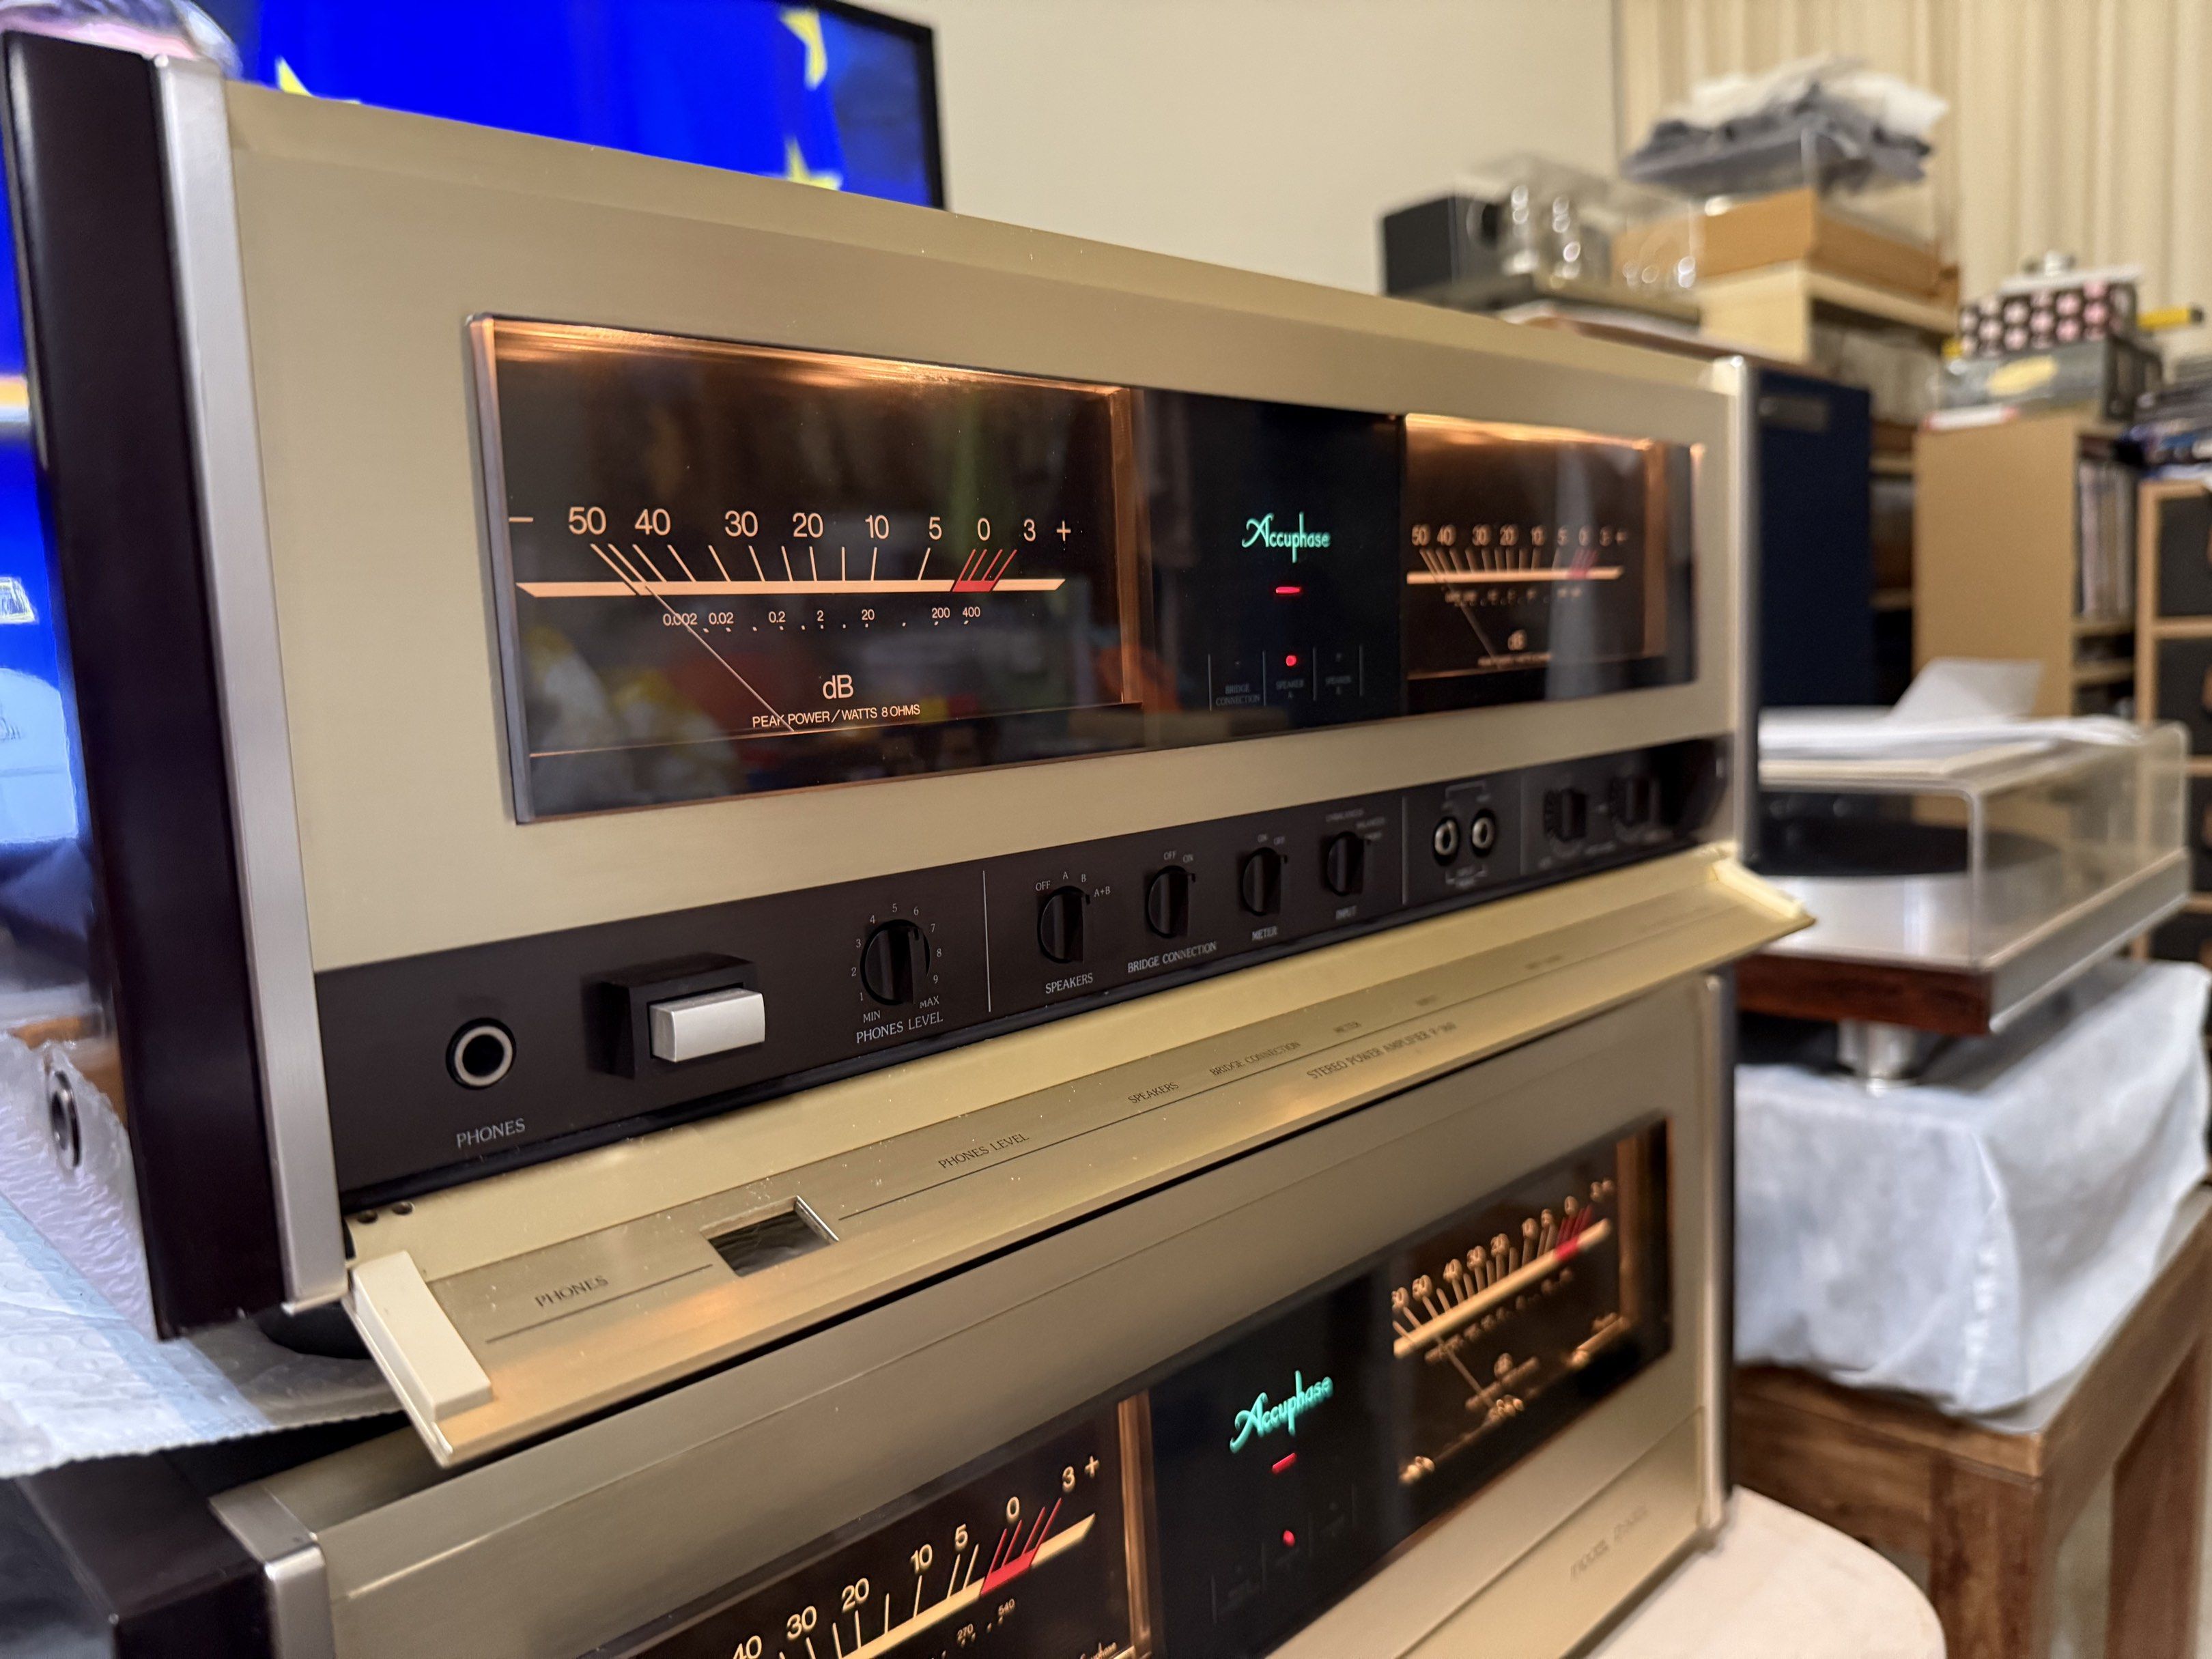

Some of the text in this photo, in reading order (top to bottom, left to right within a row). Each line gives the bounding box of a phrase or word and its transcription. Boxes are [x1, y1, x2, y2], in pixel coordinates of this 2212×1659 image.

[568, 507, 607, 535] 50
[634, 509, 671, 536] 40
[724, 510, 758, 537] 30
[793, 512, 824, 538] 20
[865, 514, 890, 539] 10
[928, 516, 942, 539] 5
[977, 517, 991, 541] 0
[1023, 519, 1036, 541] 3
[1241, 511, 1332, 563] Accuphase
[662, 606, 981, 626] 0.002 0.02 0.2 2 20 200 400
[823, 675, 853, 699] dB
[752, 714, 785, 728] PEAK
[881, 708, 888, 717] 8
[890, 704, 920, 717] OHMS
[1163, 851, 1177, 861] OFF
[1035, 871, 1111, 898] OFF A B A+B
[892, 903, 898, 913] 5
[913, 906, 919, 916] 6
[870, 915, 875, 924] 4
[931, 923, 936, 933] 7
[855, 939, 861, 948] 3
[1251, 925, 1278, 941] METER
[936, 948, 941, 957] 8
[1127, 941, 1217, 974] BRIDGE CONNECTION
[851, 967, 857, 976] 2
[933, 974, 939, 984] 9
[1045, 972, 1093, 994] SPEAKERS
[860, 992, 864, 1001] 1
[920, 995, 939, 1008] MAX
[856, 1011, 944, 1043] PHONES LEVEL
[863, 1010, 881, 1023] MIN
[1209, 1040, 1301, 1077] BRIDGE CONNECTION
[1306, 1061, 1348, 1079] STEREO
[1345, 1047, 1385, 1066] POWER
[1382, 1029, 1431, 1054] AMPLIFIER
[1128, 1081, 1180, 1104] SPEAKERS
[456, 1118, 526, 1148] PHONES
[938, 1133, 1030, 1169] PHONES LEVEL
[534, 1275, 609, 1307] PHONES
[1230, 1370, 1335, 1454] Accuphase
[733, 1635, 763, 1659] 40
[787, 1605, 817, 1641] 30
[842, 1578, 870, 1613] 20
[911, 1544, 933, 1574] 10
[955, 1524, 969, 1550] 5
[1006, 1497, 1021, 1522] 0
[1062, 1466, 1076, 1492] 3
[957, 1623, 974, 1642] 270
